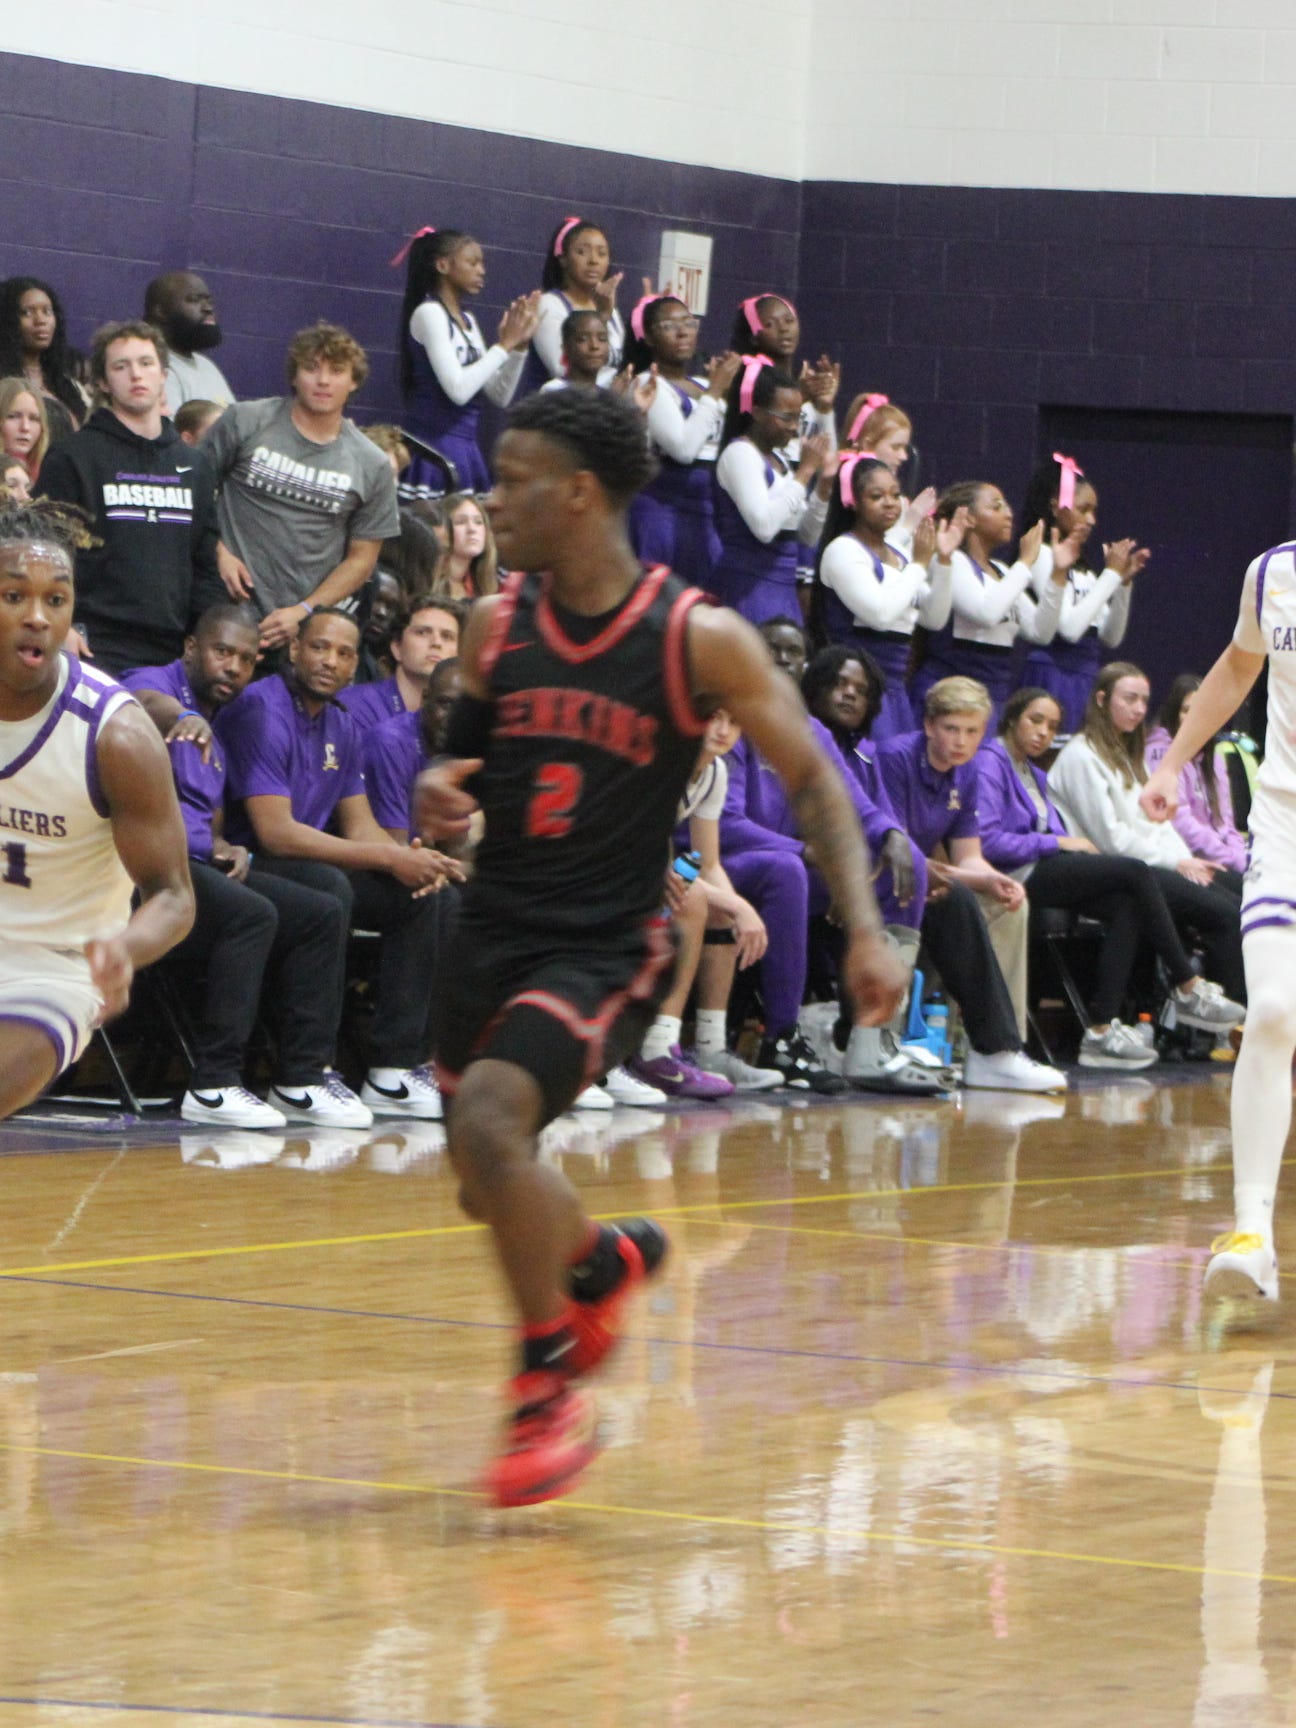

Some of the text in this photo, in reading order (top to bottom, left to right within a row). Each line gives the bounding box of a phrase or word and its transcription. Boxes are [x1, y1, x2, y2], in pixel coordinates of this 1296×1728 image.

[677, 265, 703, 312] EXIT
[102, 484, 194, 510] BASEBALL
[1273, 626, 1296, 651] CA
[528, 763, 584, 838] 2
